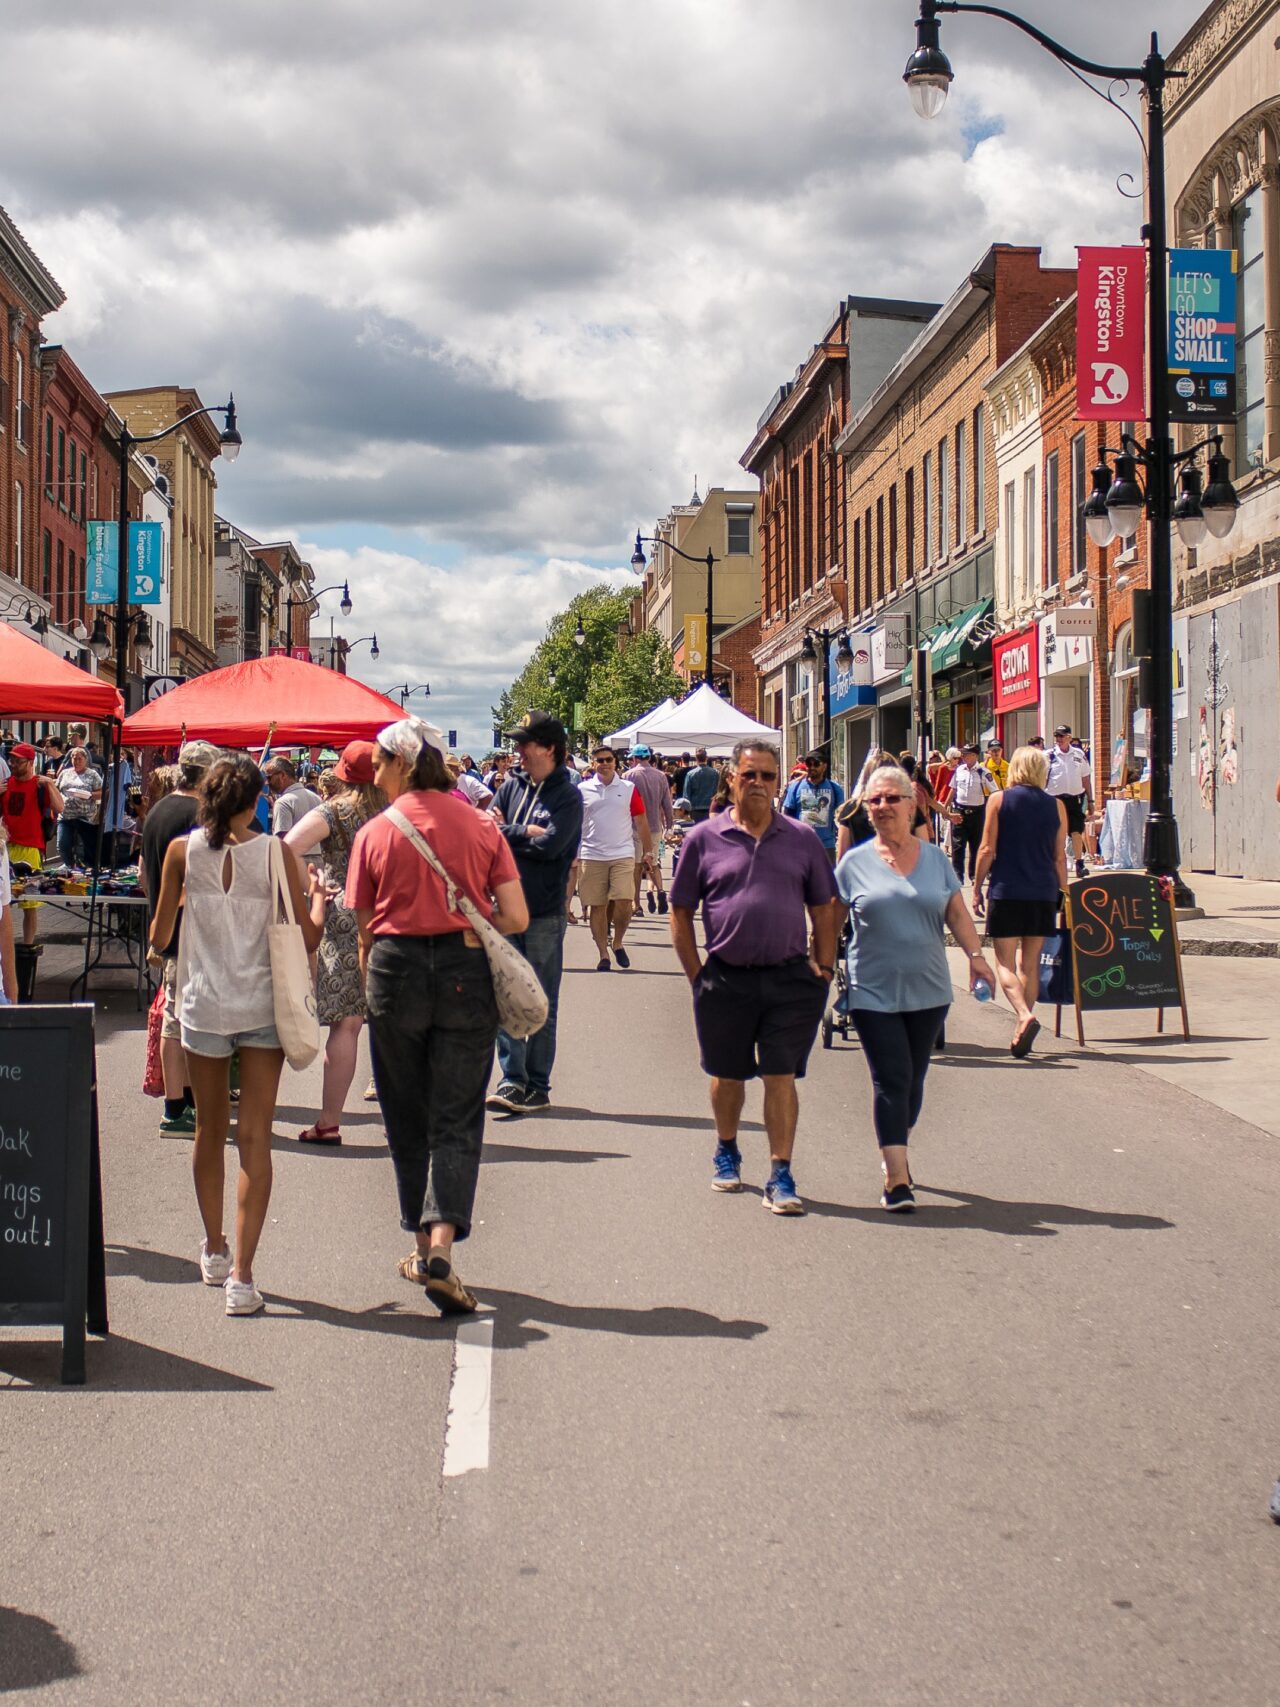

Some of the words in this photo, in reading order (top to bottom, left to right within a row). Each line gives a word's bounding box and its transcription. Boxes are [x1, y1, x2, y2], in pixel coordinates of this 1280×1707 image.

[1176, 271, 1212, 295] LET'S
[1094, 265, 1116, 352] Kingston
[1115, 266, 1128, 338] Downtown
[1175, 294, 1196, 317] GO
[1174, 317, 1217, 340] SHOP
[1174, 339, 1228, 363] SMALL.
[95, 526, 105, 551] blues
[136, 530, 147, 571] Kingston
[95, 553, 105, 588] festival
[885, 641, 903, 650] Kids
[887, 630, 901, 639] Hip
[1000, 642, 1030, 681] CROWN
[1072, 887, 1145, 957] SALE
[4, 1215, 52, 1247] out!
